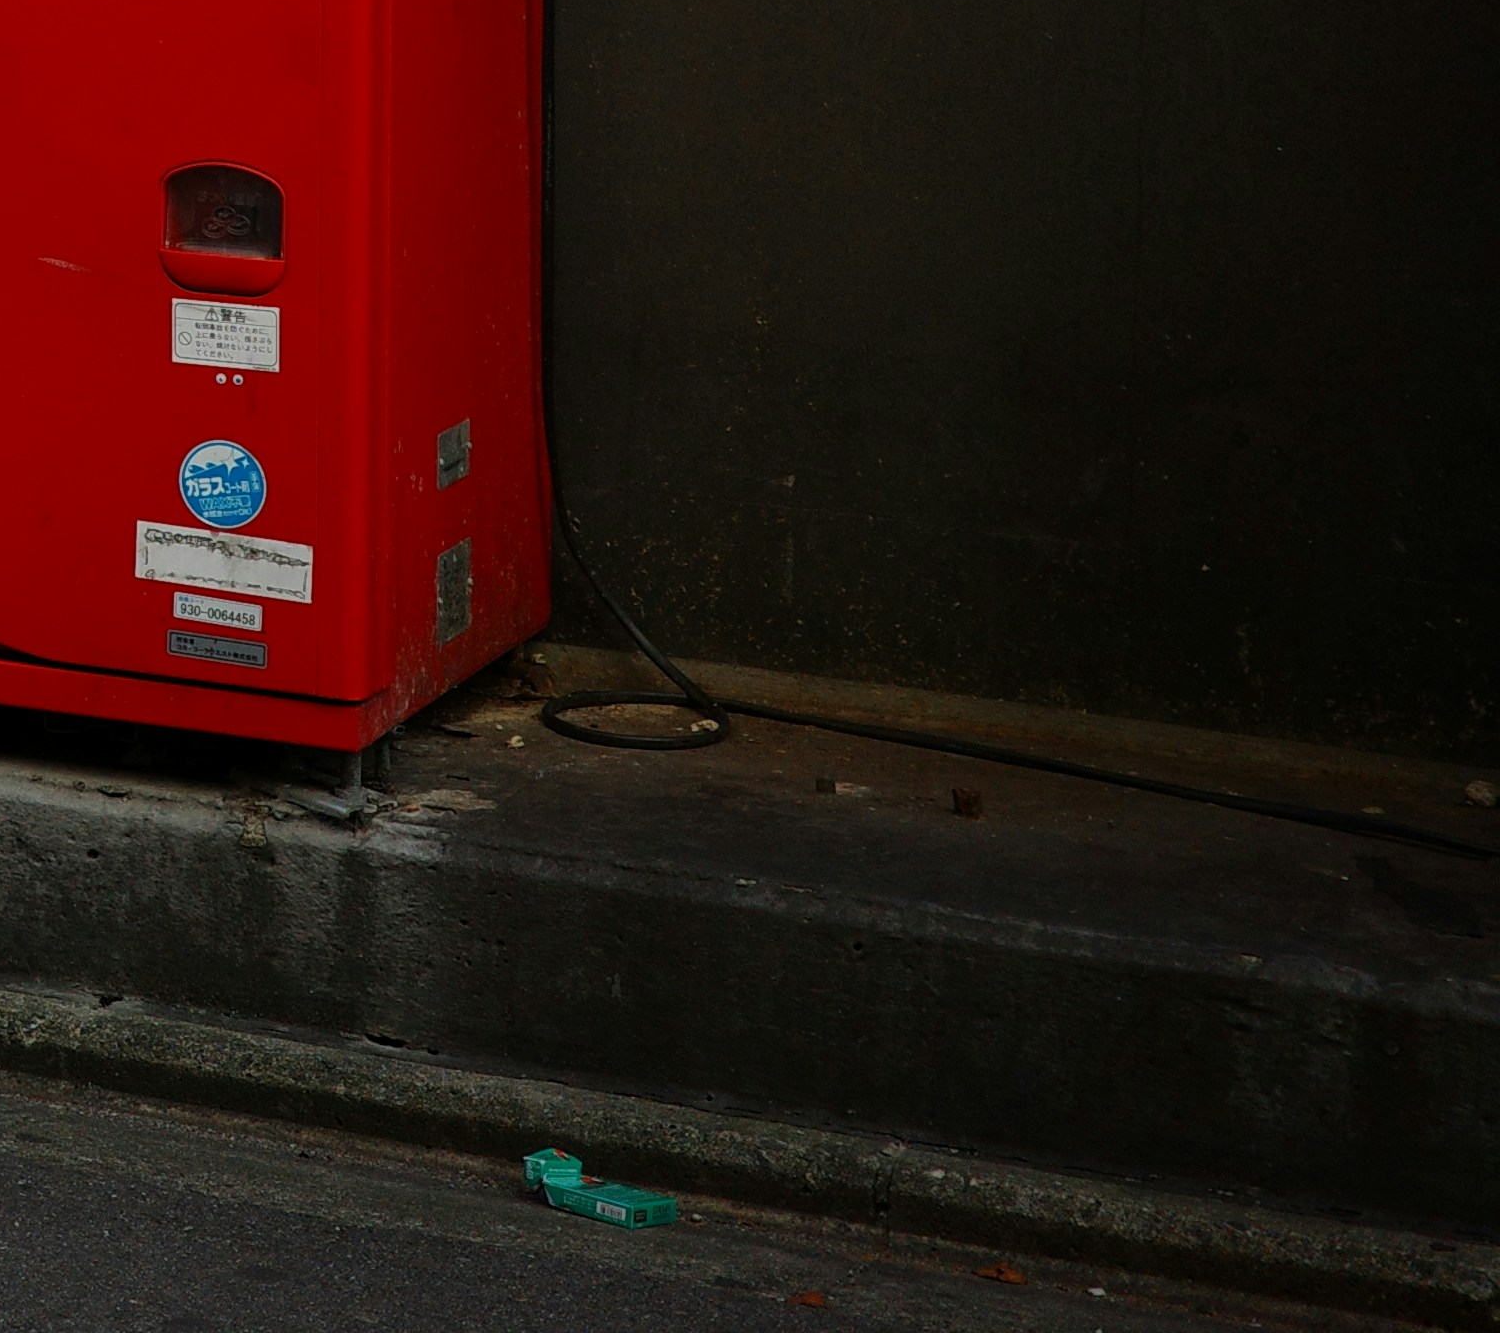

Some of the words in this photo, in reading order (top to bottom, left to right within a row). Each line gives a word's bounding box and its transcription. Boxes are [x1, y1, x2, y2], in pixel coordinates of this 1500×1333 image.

[220, 308, 246, 323] 警告
[186, 476, 224, 497] ガラス
[180, 604, 255, 626] 930-0064458
